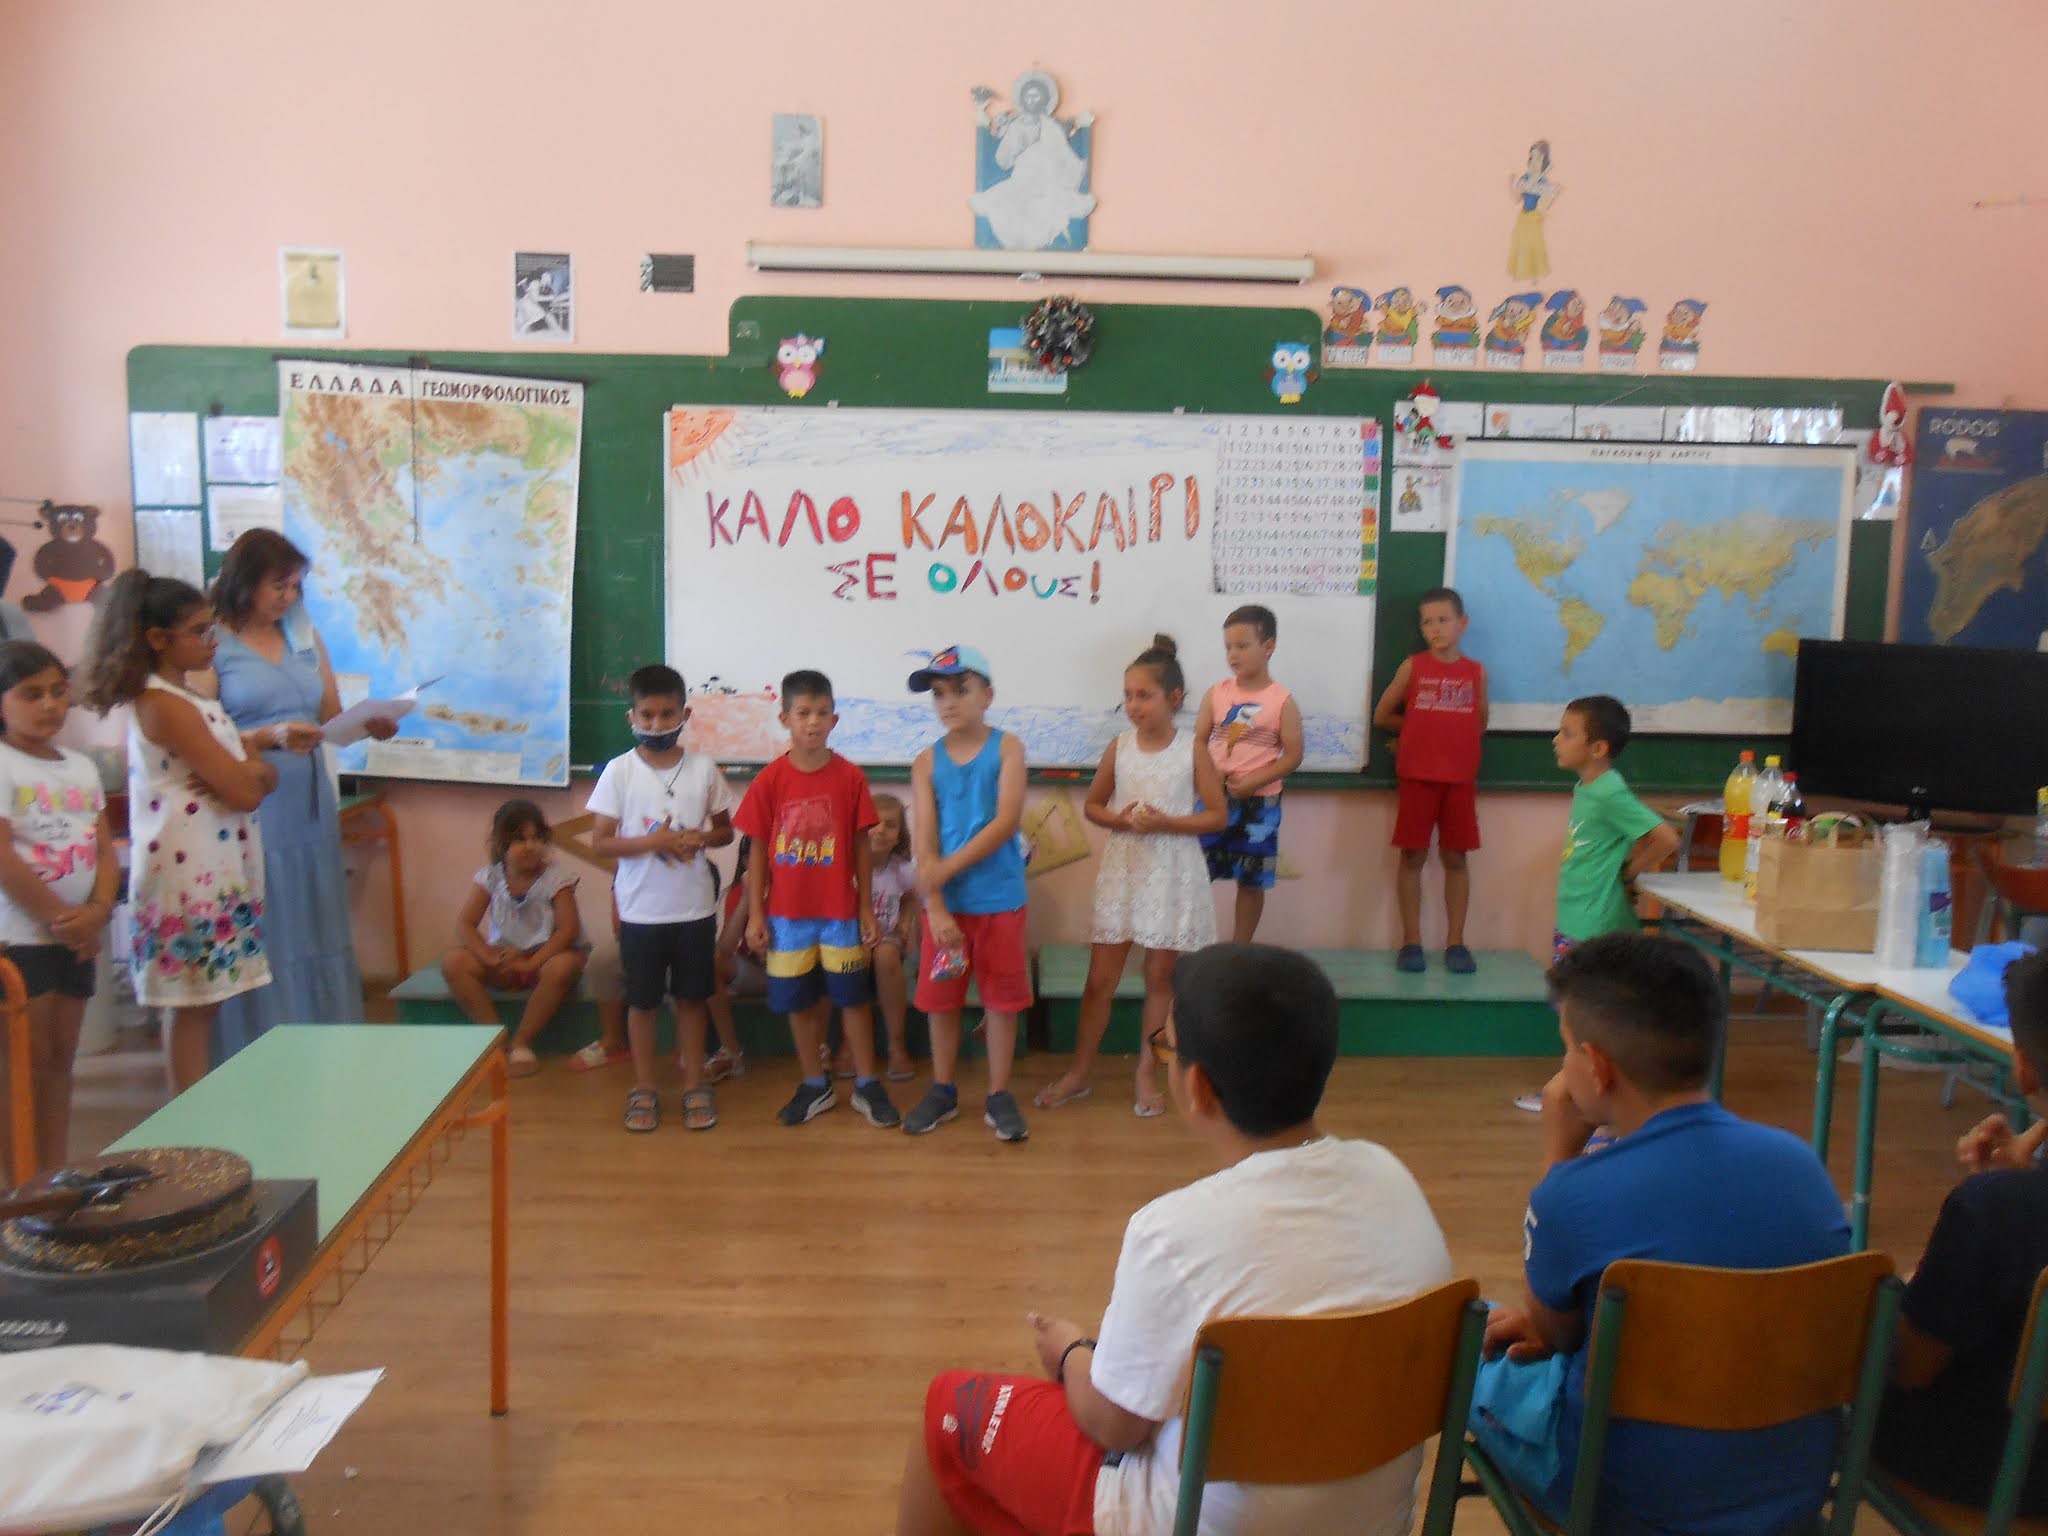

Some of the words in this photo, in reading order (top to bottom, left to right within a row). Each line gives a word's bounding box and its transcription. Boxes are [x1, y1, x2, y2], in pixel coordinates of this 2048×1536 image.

[290, 372, 404, 396] ΕΛΛΑΔΑ
[422, 381, 571, 406] ΓΕΩΜΟΡΦΟΛΟΓΙΚΟΣ
[705, 489, 861, 549] ΚΑΛΟ
[900, 472, 1200, 556] ΚΑΛΟΚΑΙΡΙ
[825, 552, 897, 601] ΣΕ
